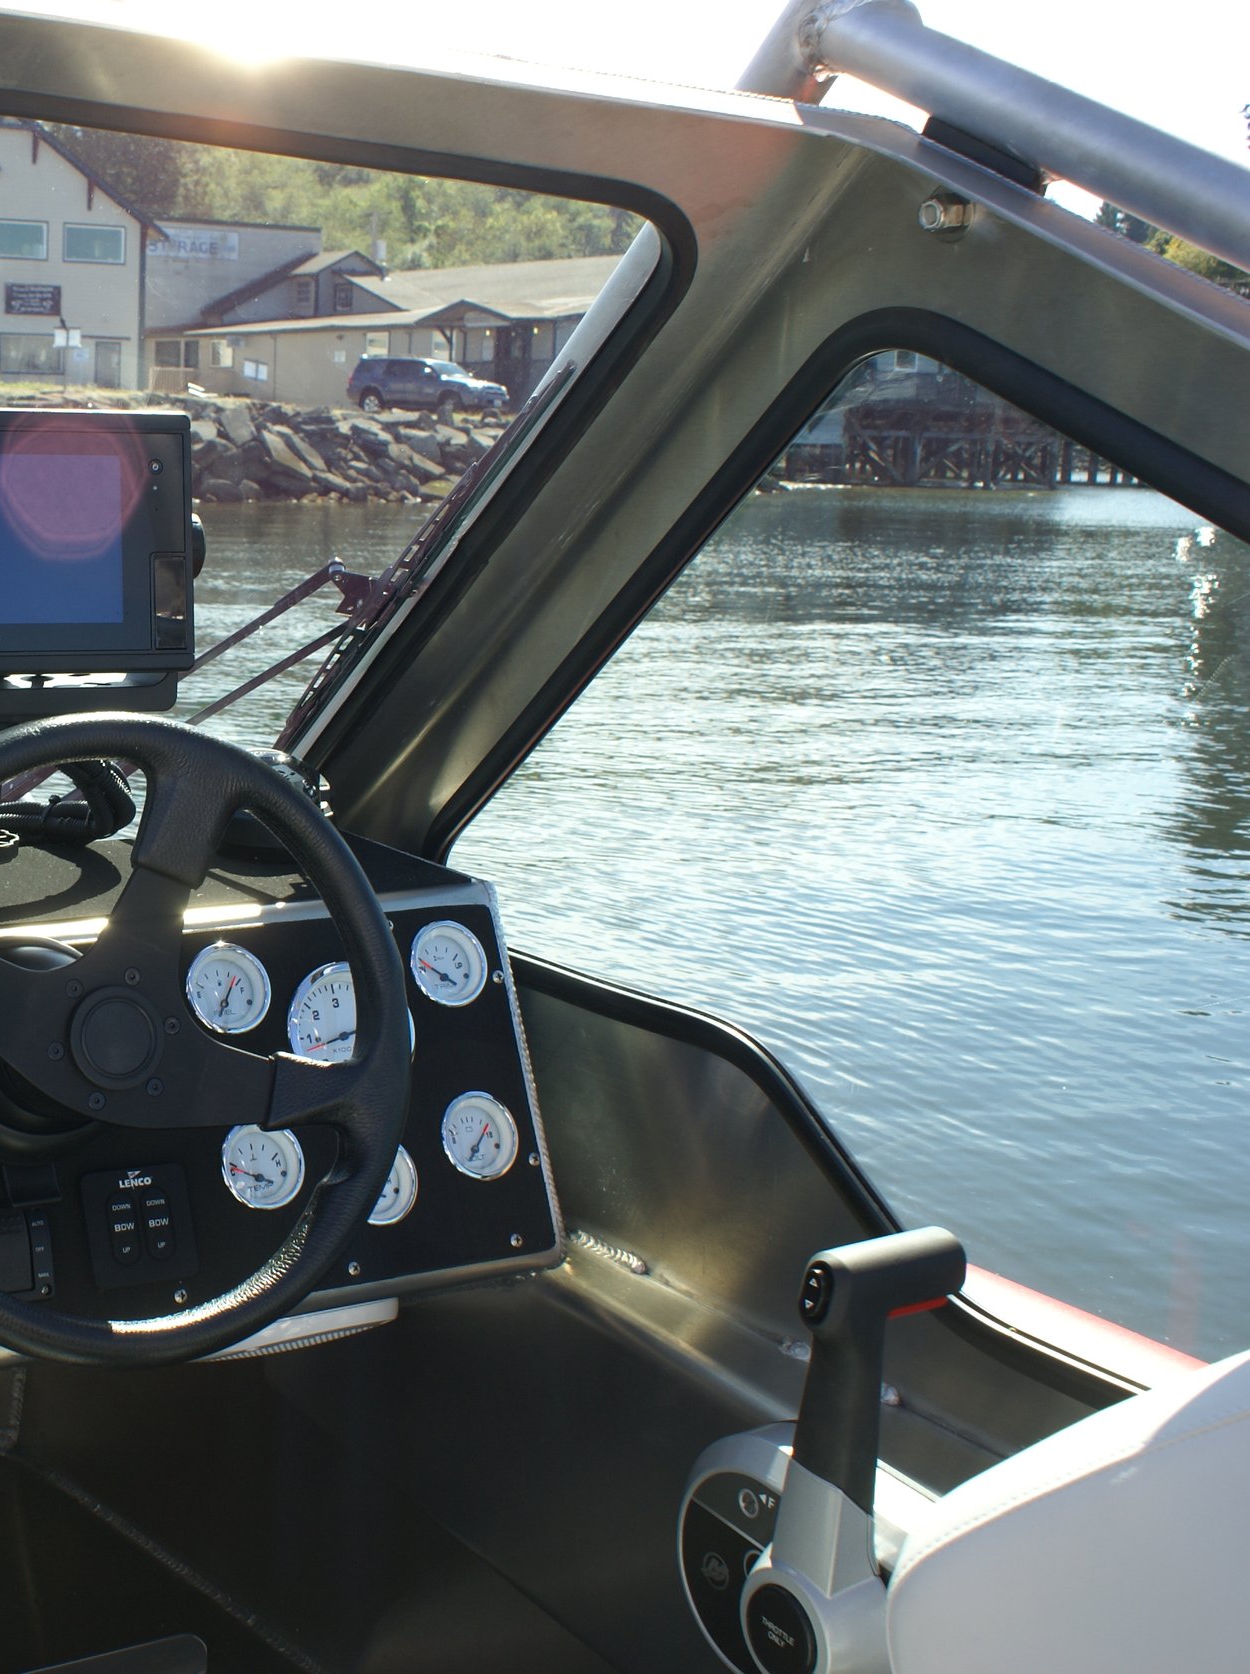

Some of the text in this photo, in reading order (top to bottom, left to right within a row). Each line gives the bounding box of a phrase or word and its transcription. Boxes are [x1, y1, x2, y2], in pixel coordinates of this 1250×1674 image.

[331, 997, 340, 1009] 3
[311, 1009, 321, 1021] 2
[306, 1033, 313, 1044] 1
[118, 1176, 152, 1189] LENCO
[111, 1203, 131, 1211] DOWN
[146, 1198, 166, 1206] DOWN
[114, 1222, 135, 1232] BOW
[148, 1217, 169, 1228] BOW
[761, 1615, 796, 1647] THROTTLE
[767, 1631, 786, 1649] ONLY
